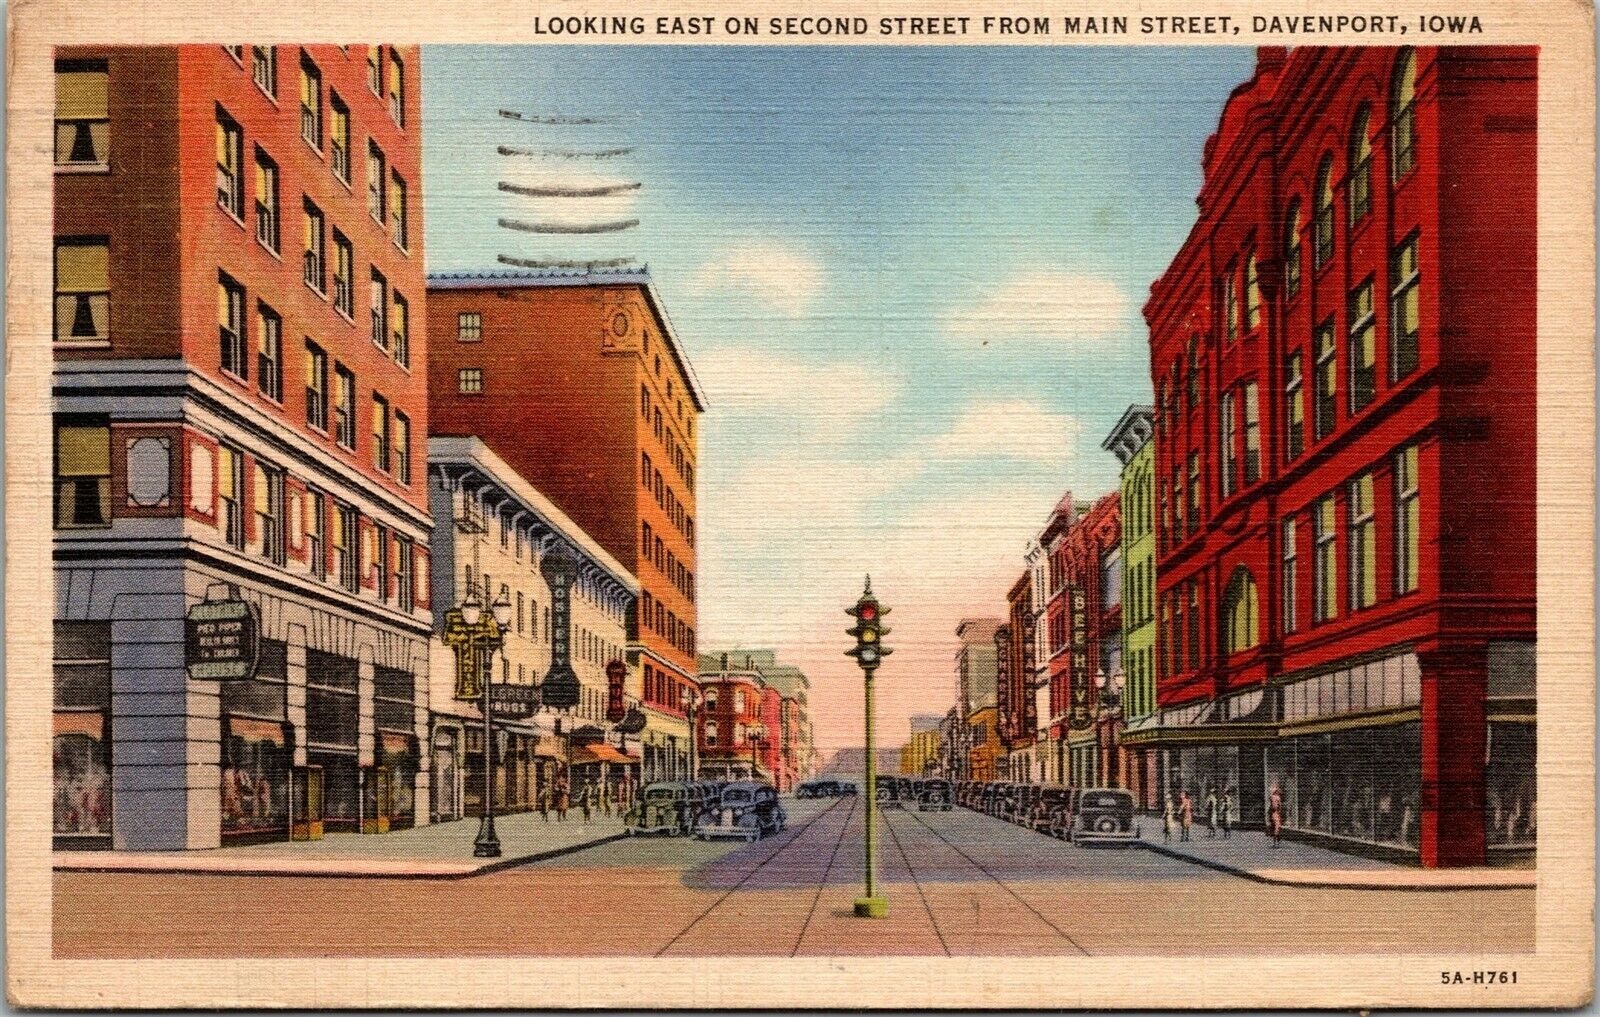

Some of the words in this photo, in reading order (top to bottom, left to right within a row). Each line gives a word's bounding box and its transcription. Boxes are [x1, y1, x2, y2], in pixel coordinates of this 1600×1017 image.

[554, 574, 567, 667] HOSIERY
[1073, 596, 1086, 643] BEE
[1073, 654, 1087, 720] HIVE
